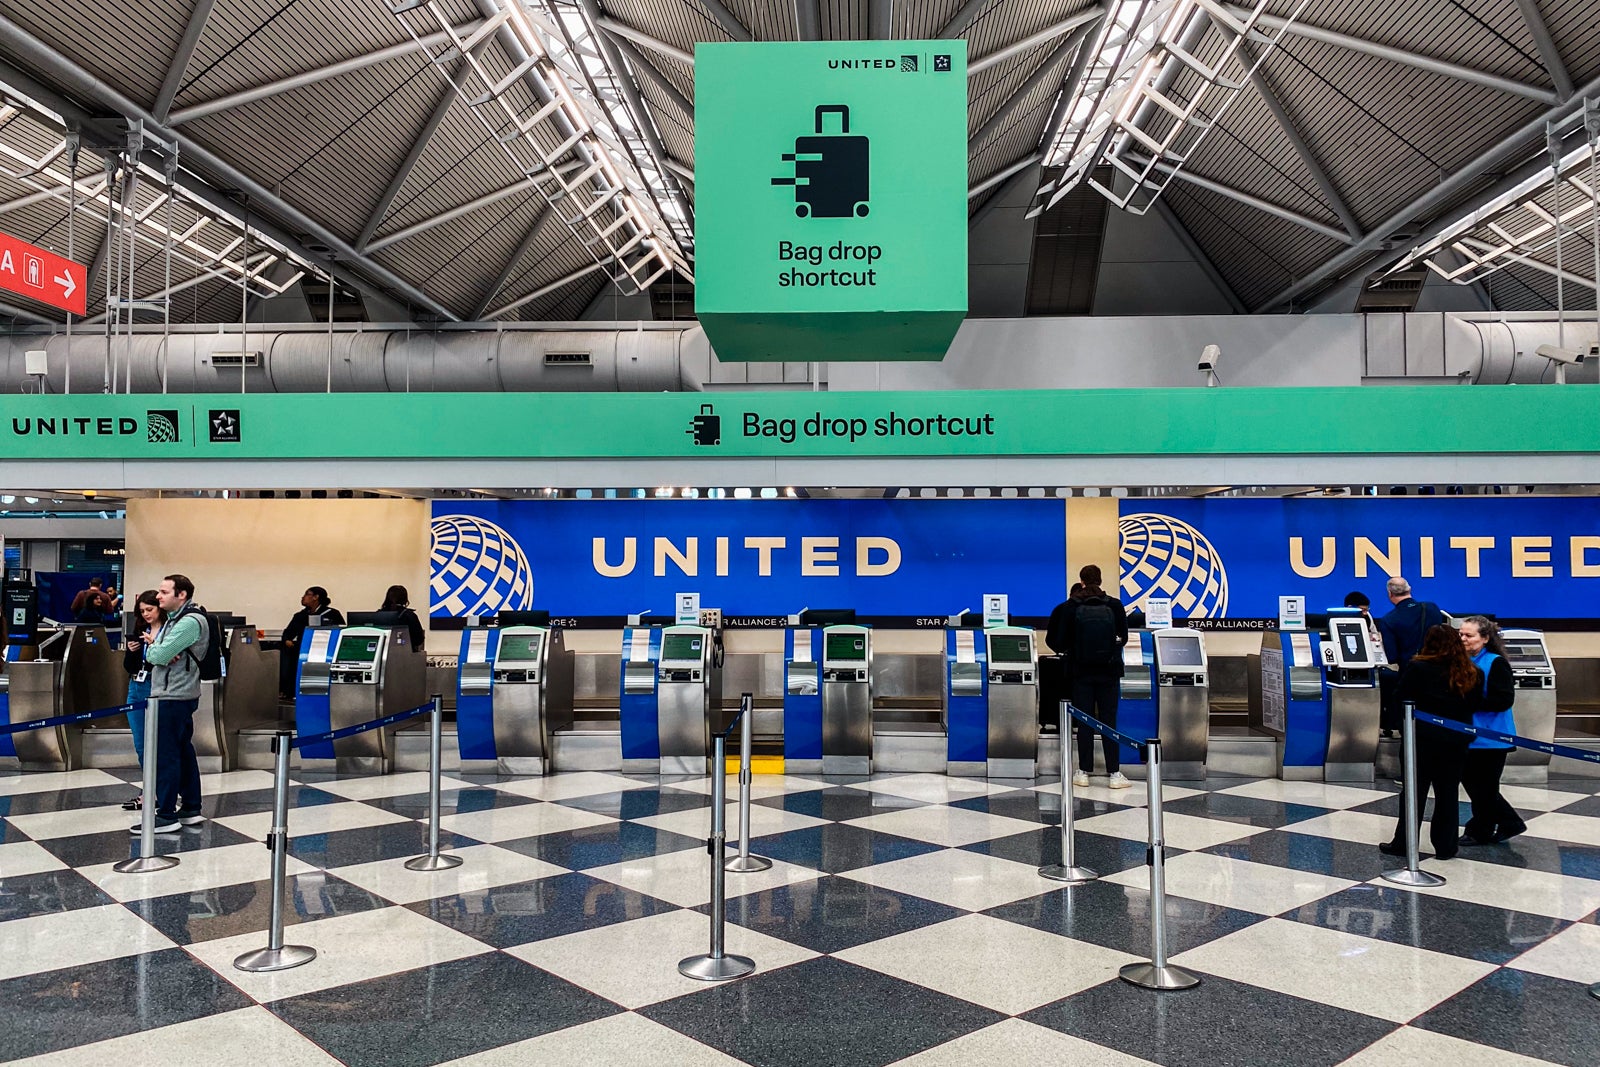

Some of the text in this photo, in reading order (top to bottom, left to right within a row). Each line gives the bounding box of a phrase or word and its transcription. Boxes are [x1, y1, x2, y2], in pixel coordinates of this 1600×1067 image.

[828, 59, 896, 69] UNITED
[779, 240, 882, 266] Bag drop
[778, 266, 877, 287] shortcut
[12, 417, 138, 435] UNITED
[743, 411, 995, 444] Bag drop shortcut
[592, 536, 902, 578] UNITED
[1289, 536, 1600, 578] UNITED
[731, 618, 777, 626] ALLIANCE
[916, 618, 941, 626] STAR
[1187, 620, 1264, 628] STAR ALLIANCE
